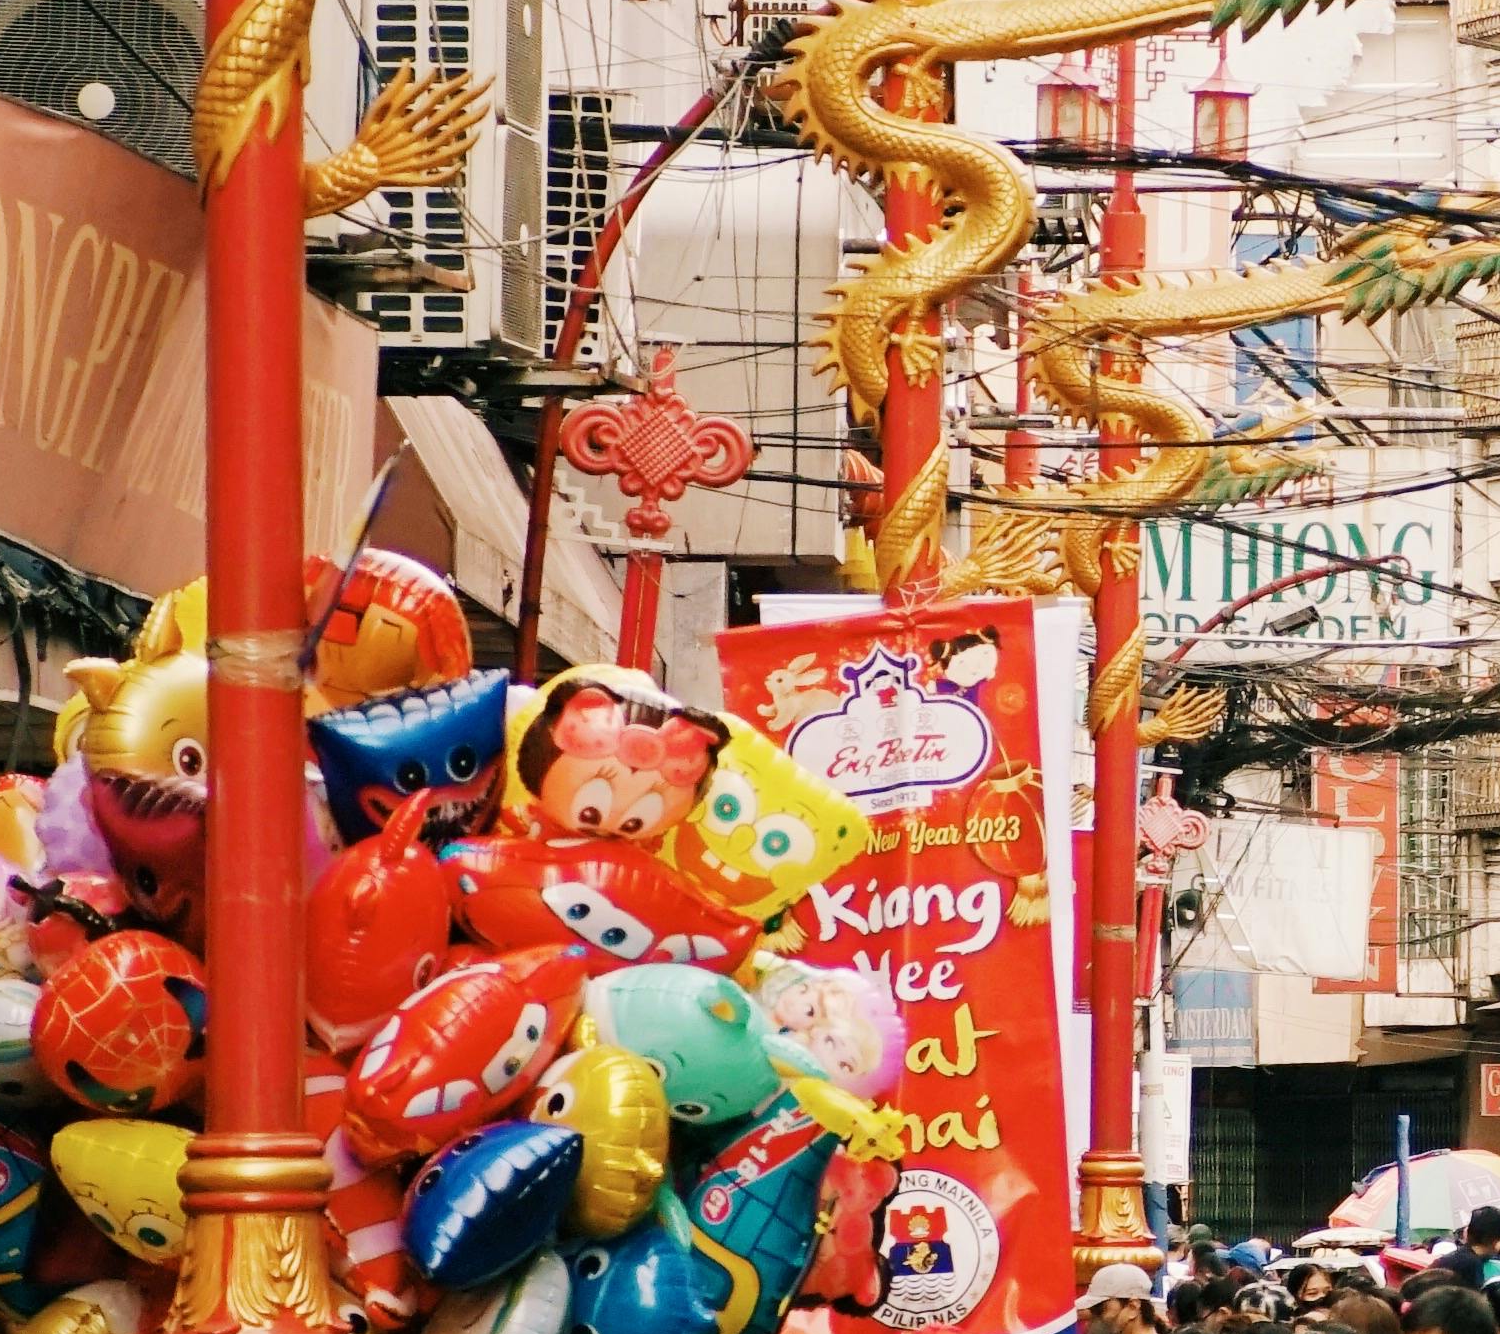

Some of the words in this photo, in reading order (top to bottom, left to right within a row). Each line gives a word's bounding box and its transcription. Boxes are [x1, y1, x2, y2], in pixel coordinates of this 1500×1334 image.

[1216, 520, 1437, 605] HIONG
[867, 829, 901, 855] New
[906, 820, 962, 855] Year
[965, 816, 1020, 845] 2023
[906, 1002, 1002, 1077] at
[935, 1177, 994, 1240] MAYNILA
